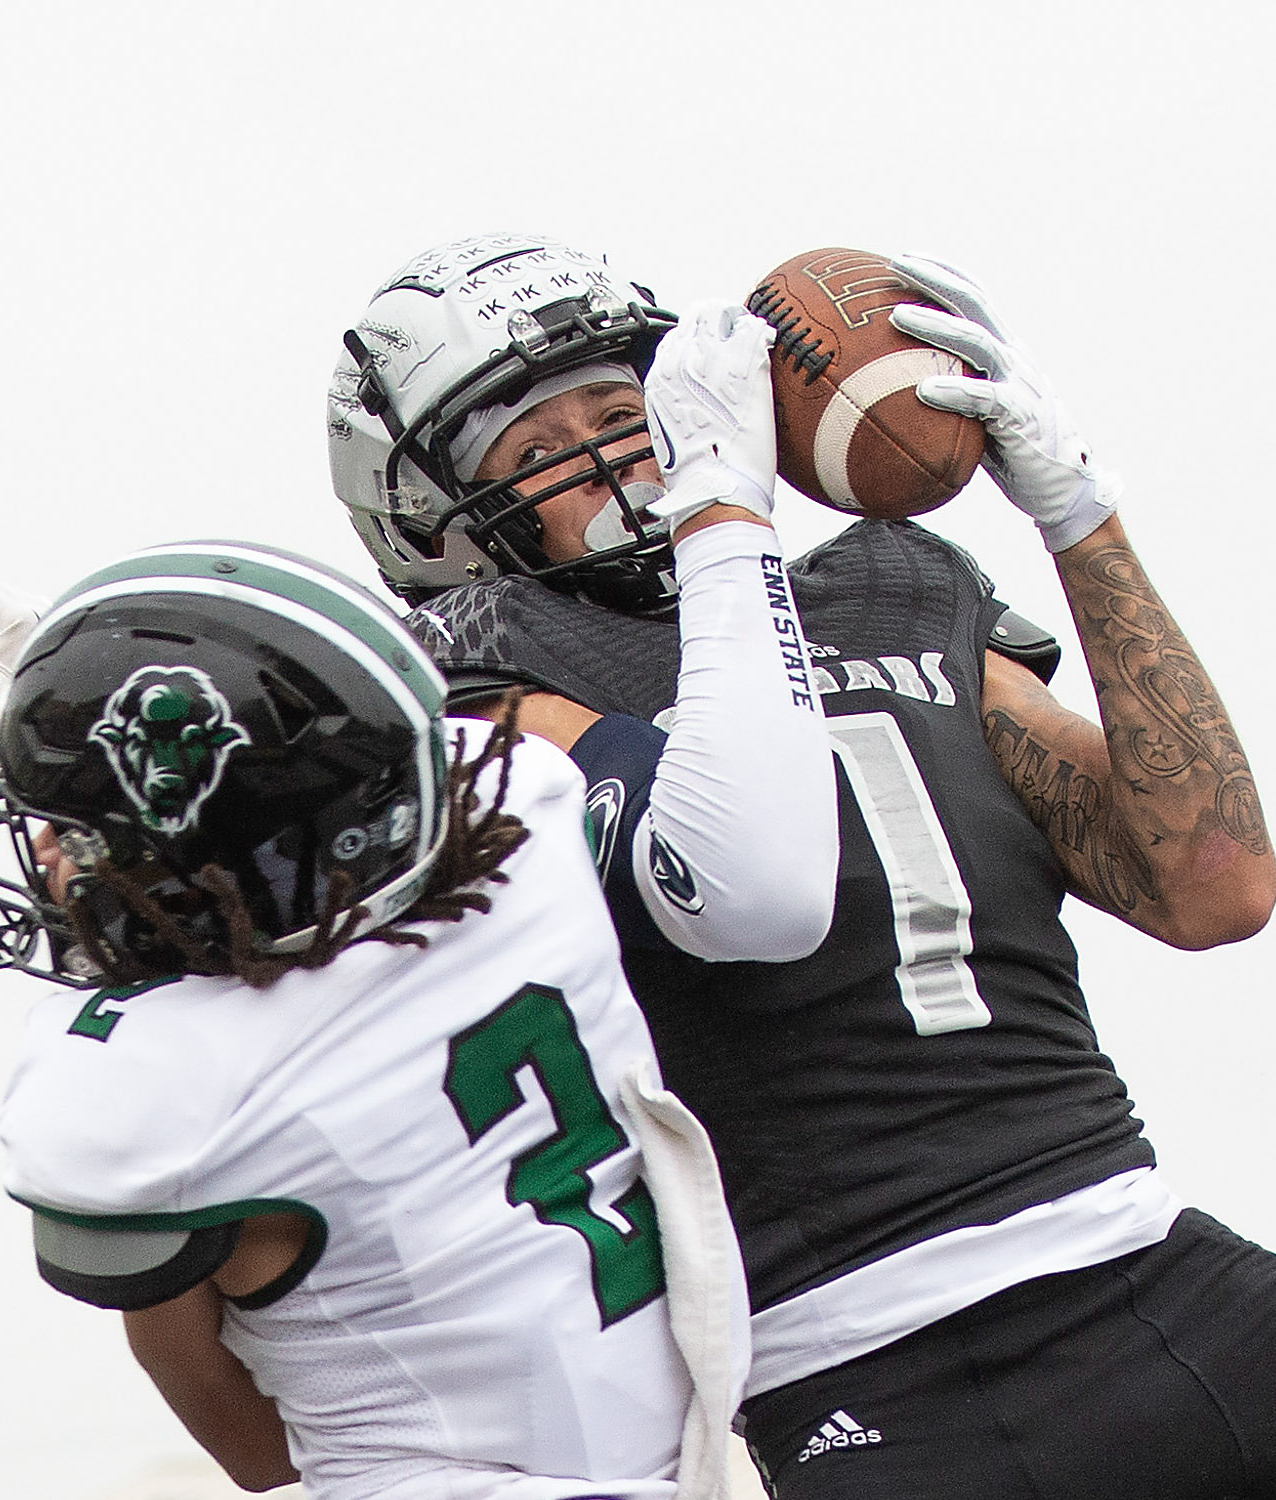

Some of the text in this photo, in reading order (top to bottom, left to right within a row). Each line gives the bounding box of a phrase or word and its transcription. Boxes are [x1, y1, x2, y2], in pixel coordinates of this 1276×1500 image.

[457, 247, 485, 260] 1K
[527, 251, 556, 264] 1K
[423, 264, 450, 281] 1K
[492, 261, 521, 277] 1K
[459, 276, 487, 296] 1K
[550, 272, 578, 289] 1K
[512, 284, 541, 303] 1K
[478, 298, 506, 321] 1K
[773, 616, 815, 712] STATE
[824, 711, 992, 1036] 1
[442, 981, 667, 1333] 2
[798, 1428, 883, 1462] adidas
